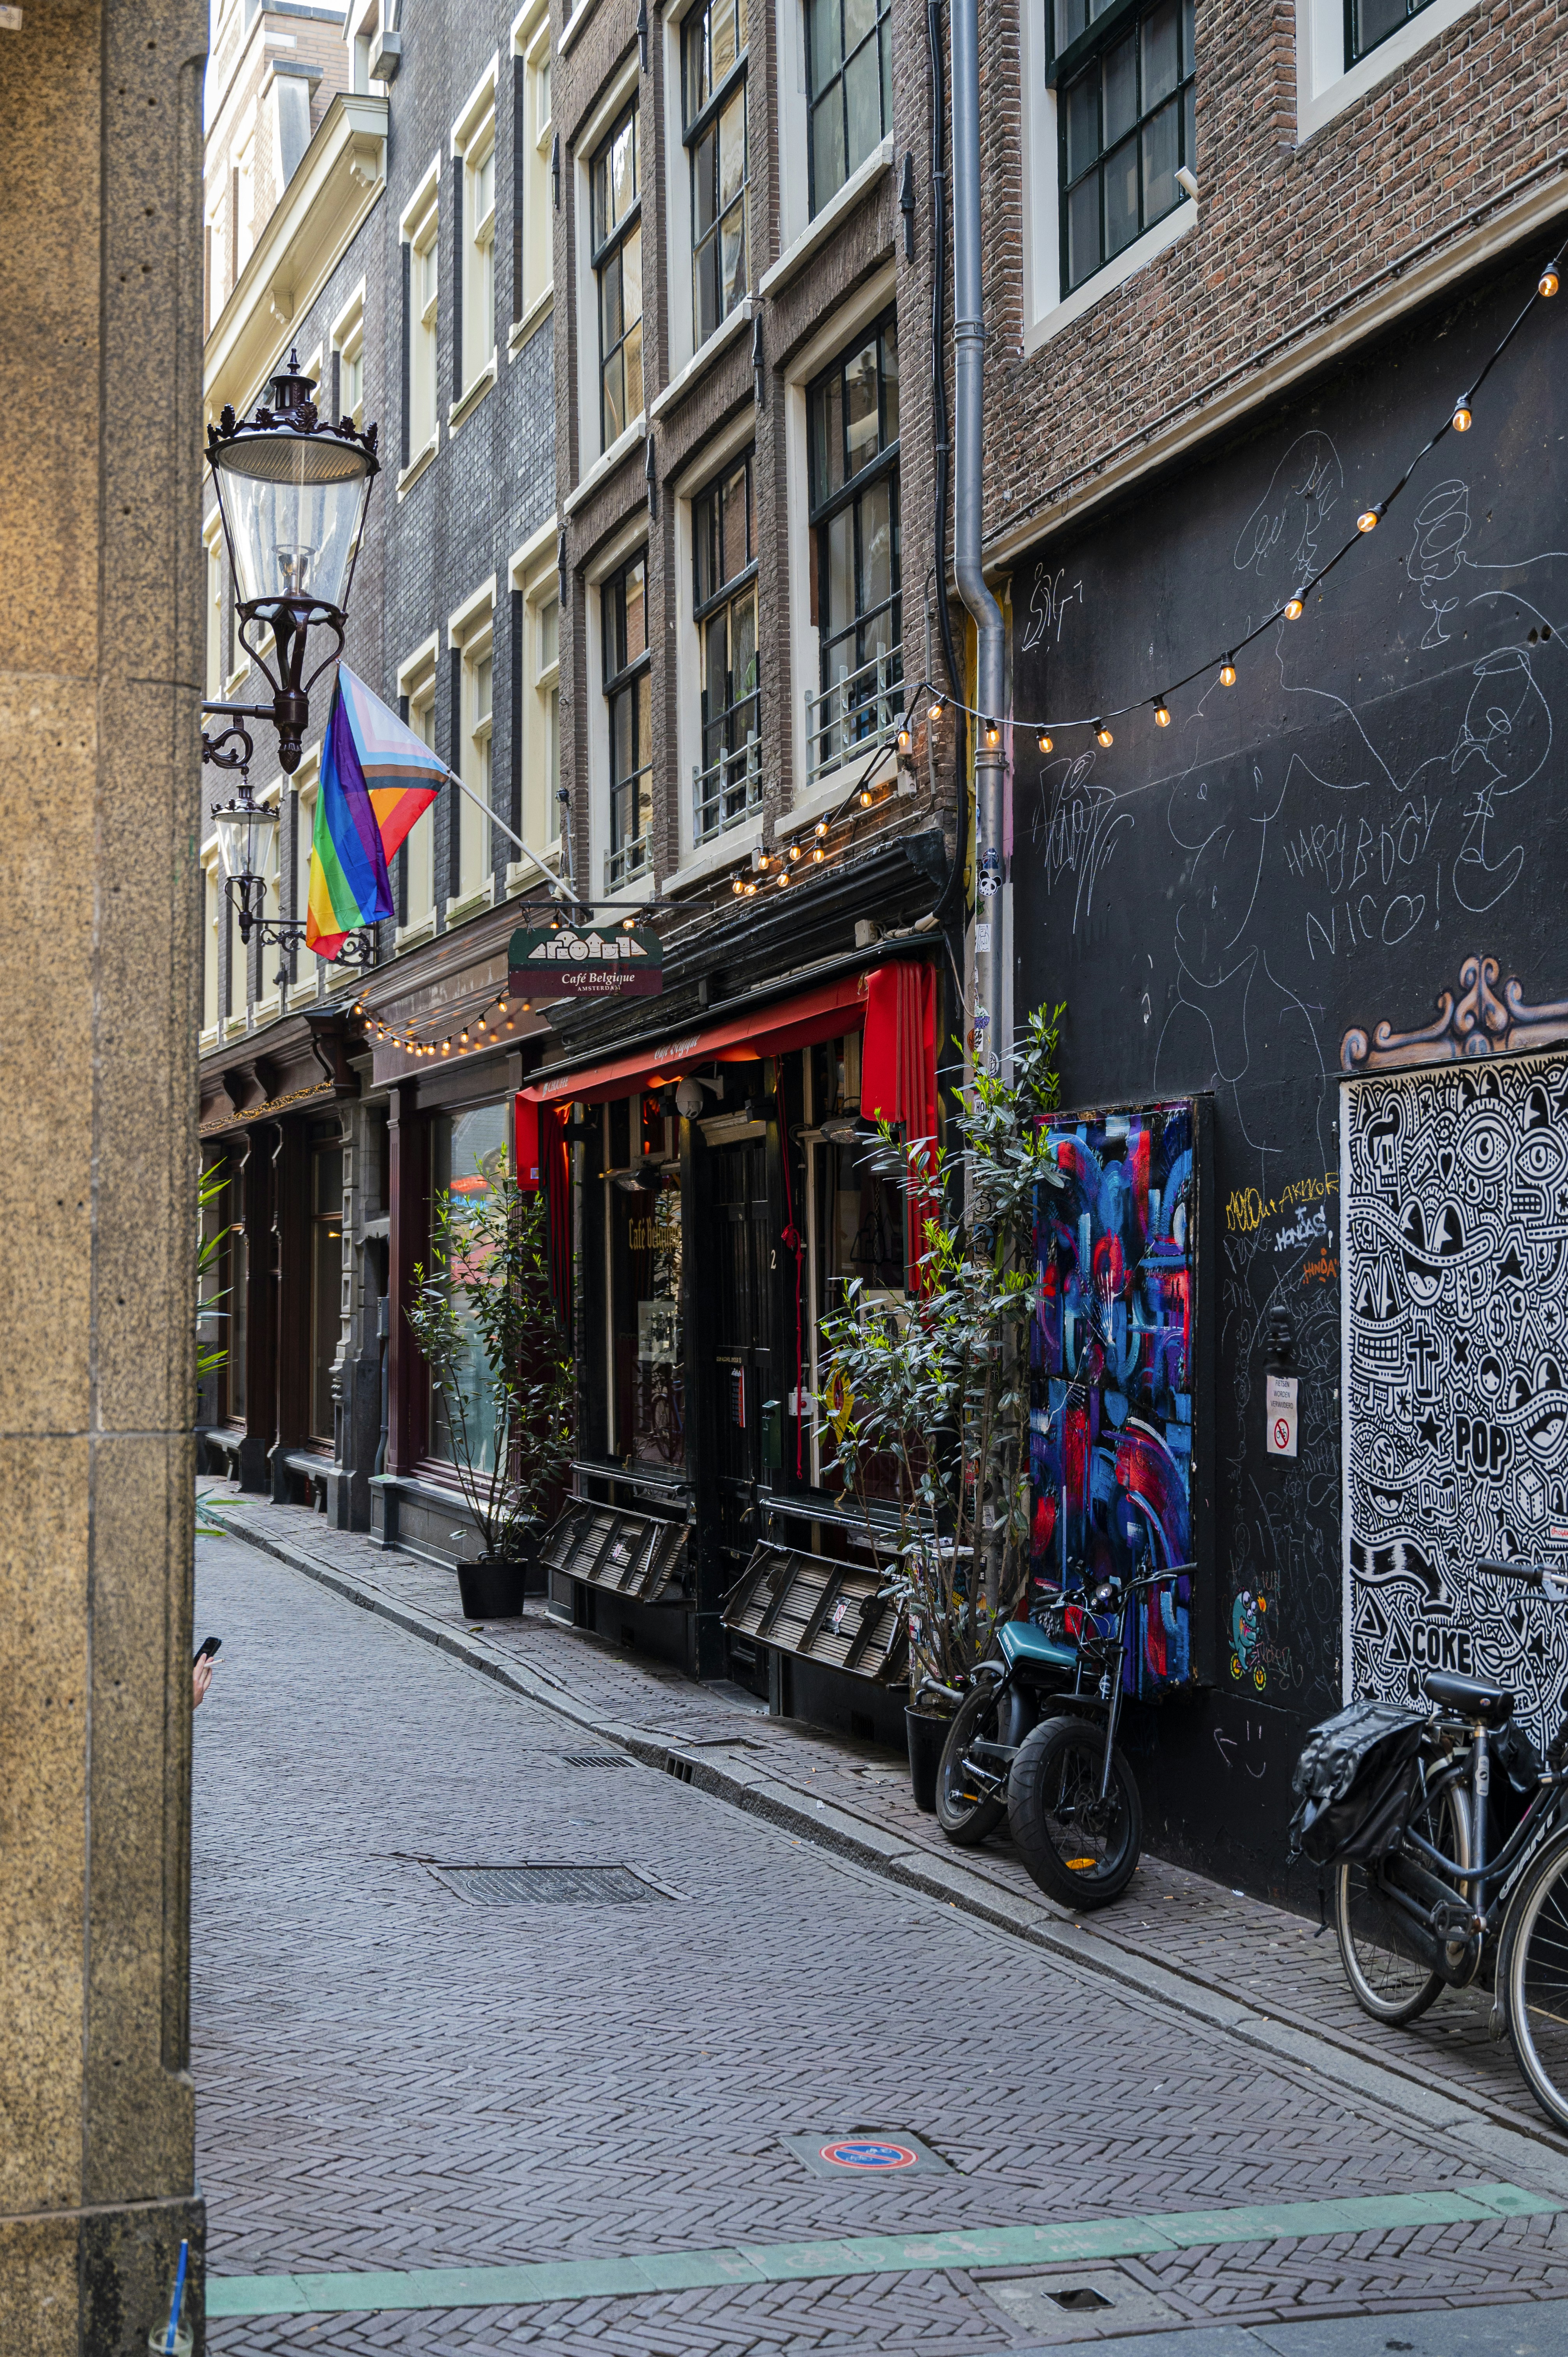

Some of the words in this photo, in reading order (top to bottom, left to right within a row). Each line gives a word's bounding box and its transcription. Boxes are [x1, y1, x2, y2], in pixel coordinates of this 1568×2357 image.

[562, 972, 586, 986] Café
[589, 973, 635, 985] Belgique
[770, 1249, 776, 1269] 2
[1275, 1380, 1290, 1388] FIETSEN
[1273, 1390, 1291, 1399] WORDEN
[1455, 1415, 1508, 1472] POP
[1423, 1484, 1455, 1511] AUDIO
[1412, 1624, 1473, 1675] COKE
